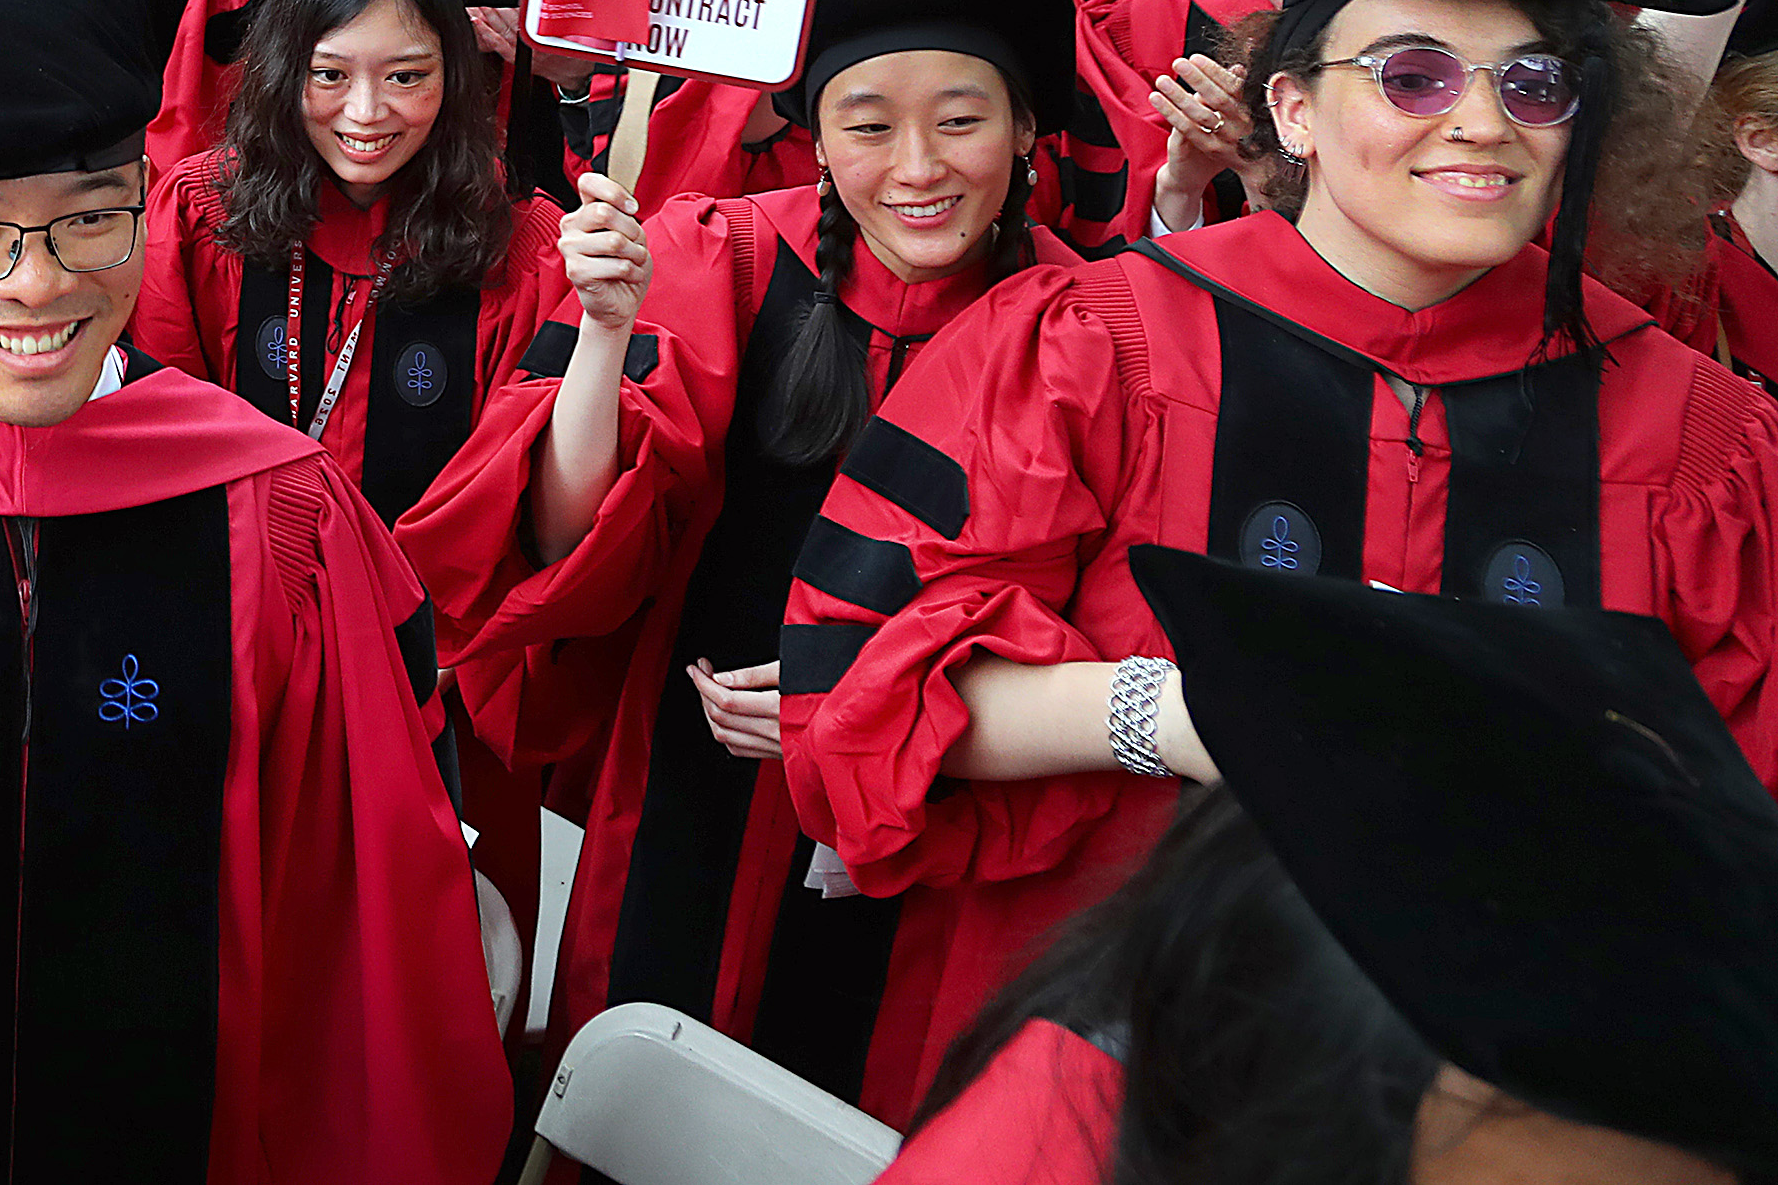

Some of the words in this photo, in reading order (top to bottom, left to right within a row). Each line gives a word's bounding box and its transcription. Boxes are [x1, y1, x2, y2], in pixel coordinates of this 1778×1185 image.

[625, 23, 689, 58] OW
[289, 240, 303, 317] UNIVERS
[289, 336, 301, 418] ARVARD
